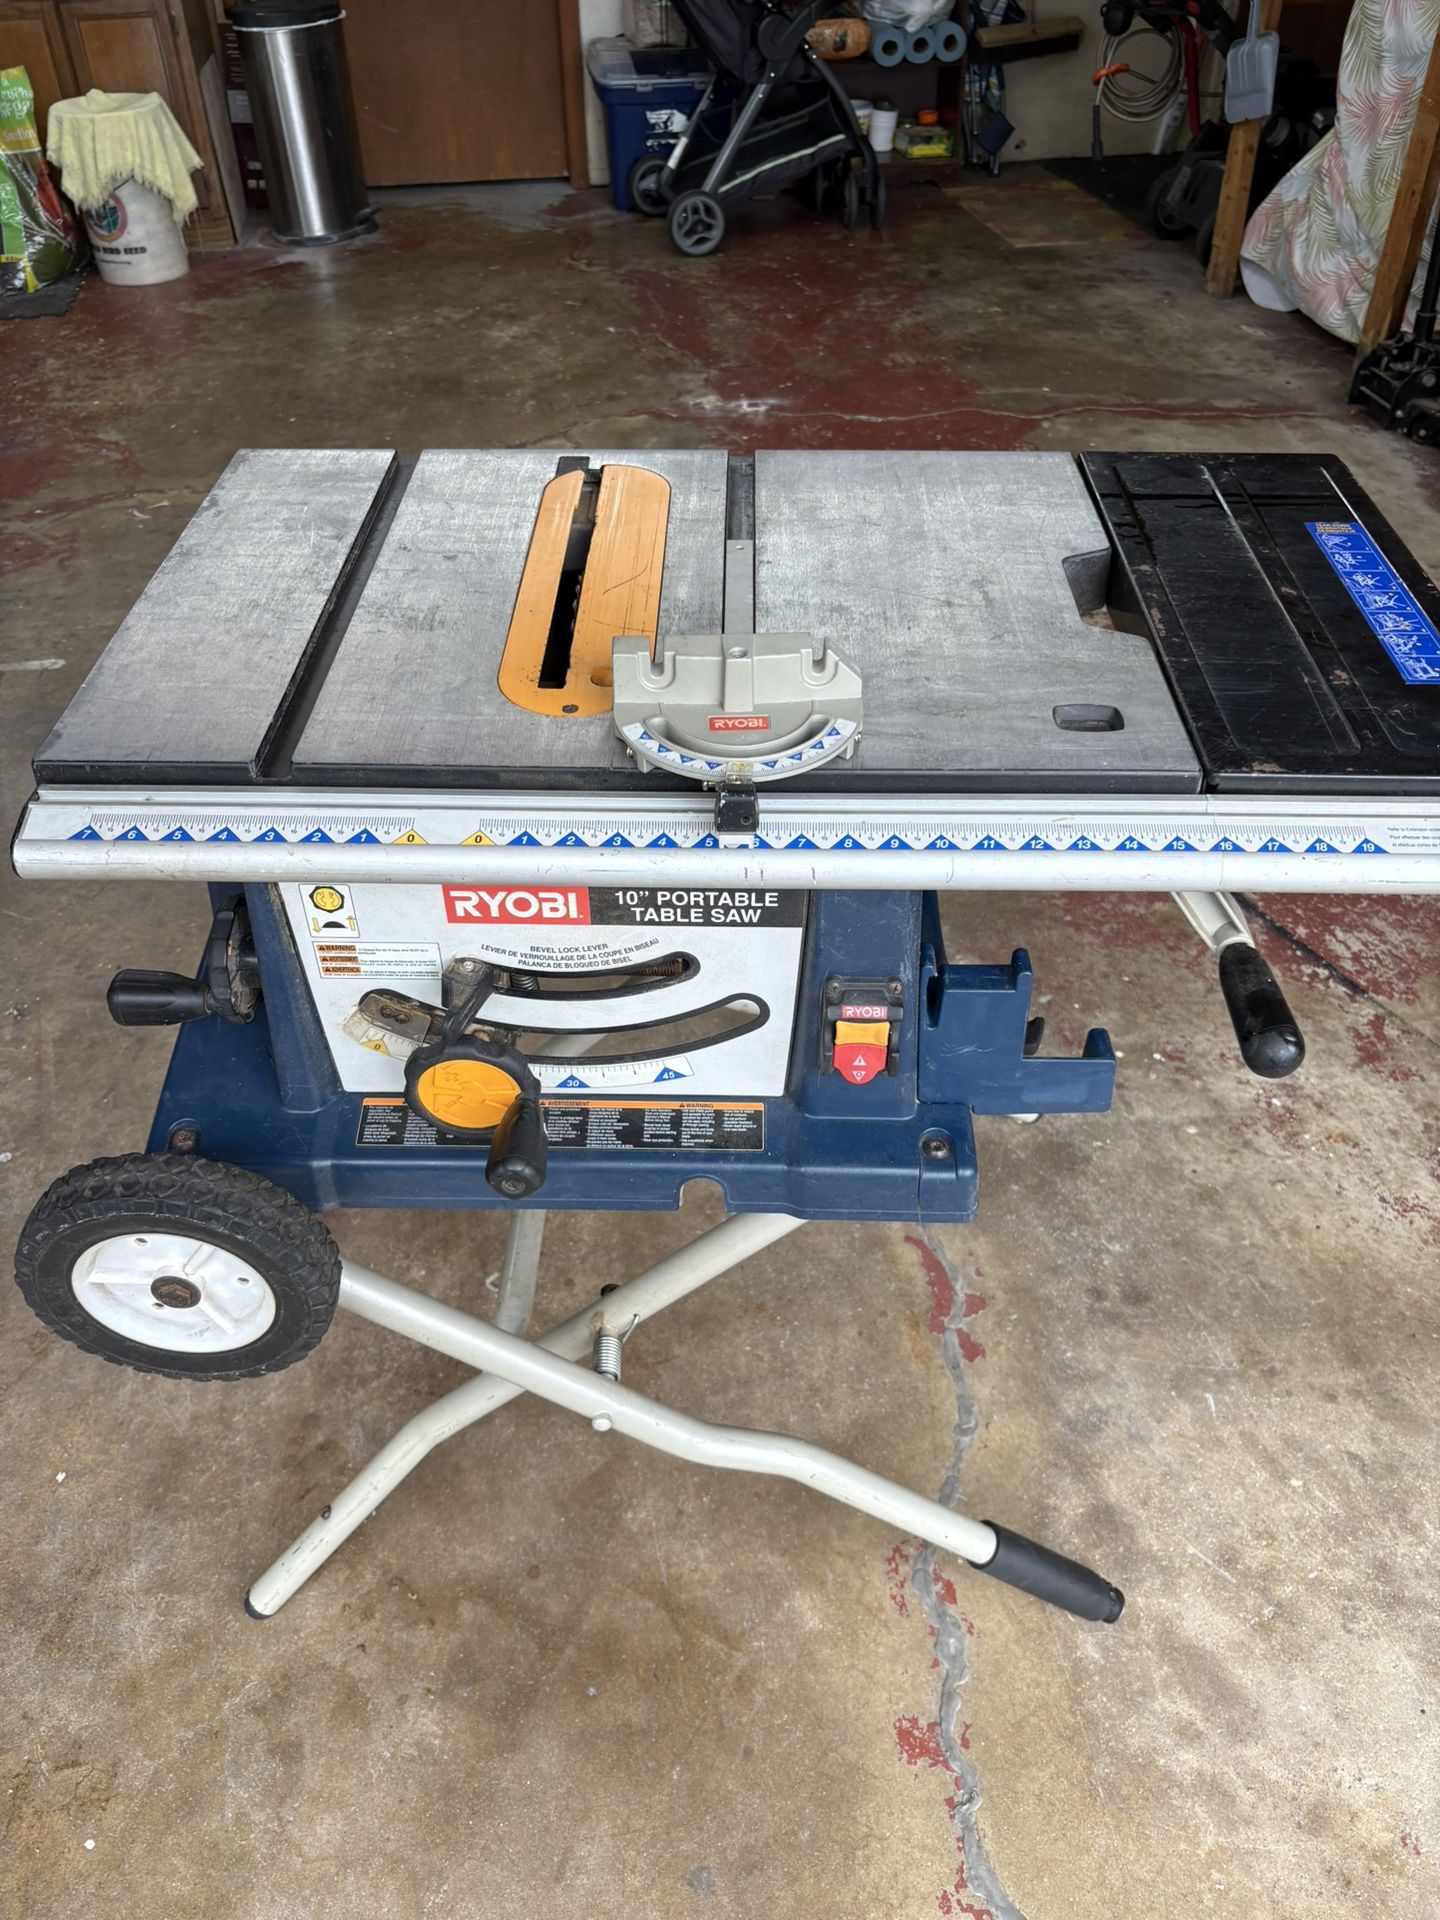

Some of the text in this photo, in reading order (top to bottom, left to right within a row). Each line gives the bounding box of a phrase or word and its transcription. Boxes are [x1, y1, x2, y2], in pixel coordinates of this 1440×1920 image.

[713, 719, 764, 728] RYOBI
[82, 830, 415, 842] 7 6 5 4 3 2 1 0
[474, 835, 482, 844] 0
[521, 836, 528, 844] 1
[566, 836, 576, 845] 2
[612, 837, 622, 846] 3
[658, 837, 667, 846] 4
[705, 838, 714, 847] 5
[798, 839, 807, 847] 7
[844, 840, 853, 848] 8
[890, 840, 899, 848] 9
[935, 840, 949, 848] 10
[982, 840, 995, 848] 11
[1029, 840, 1044, 848] 12
[1076, 840, 1091, 849] 13
[1124, 841, 1138, 849] 14
[1171, 841, 1185, 850] 15
[1219, 842, 1233, 850] 16
[1267, 842, 1279, 851] 17
[1314, 842, 1328, 851] 18
[1362, 843, 1375, 852] 19
[449, 890, 577, 920] RYOBI
[656, 890, 779, 908] PORTABLE
[631, 907, 762, 923] TABLE SAW
[481, 943, 506, 956] LEVIER
[519, 951, 575, 961] VERROUILLAGE
[576, 952, 586, 961] DE
[587, 951, 598, 959] LA
[599, 948, 623, 959] COUPE
[625, 946, 634, 954] EN
[634, 938, 659, 952] BISEAU
[530, 943, 609, 953] BEVEL LOCK LEVER
[518, 960, 552, 968] PALANCA
[553, 961, 563, 969] DE
[564, 960, 599, 969] BLOQUEO
[612, 955, 632, 965] BISEL
[846, 1006, 885, 1017] RYOBI
[662, 1071, 675, 1080] 45
